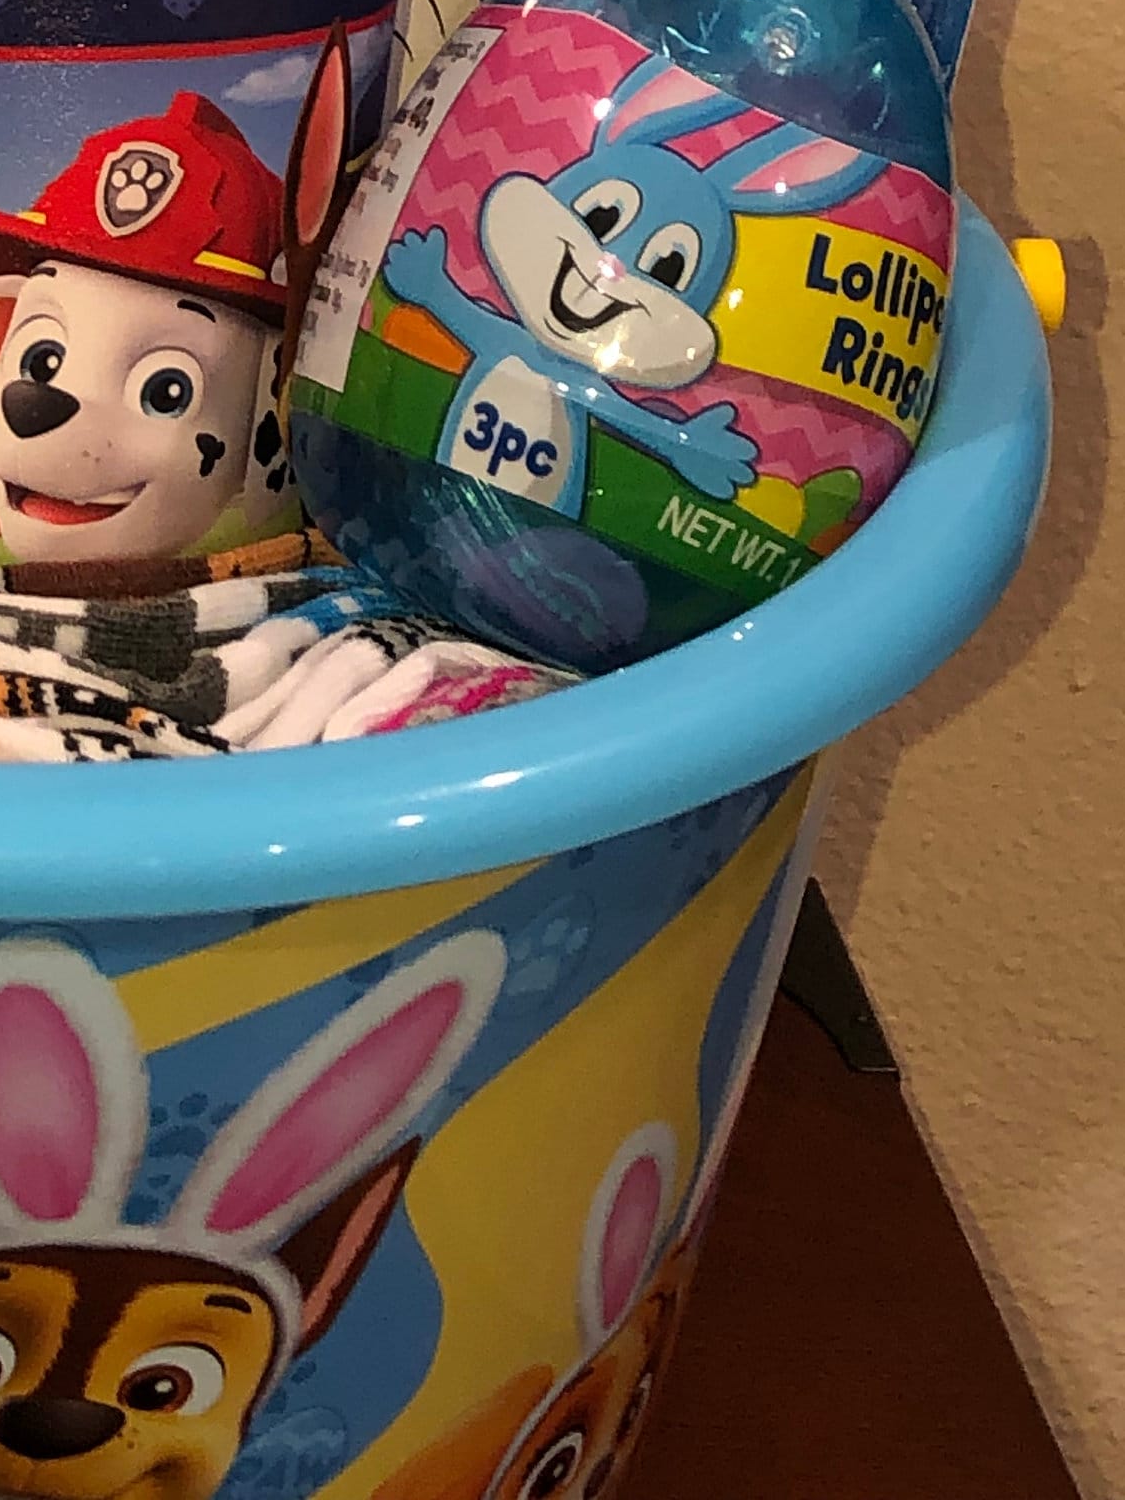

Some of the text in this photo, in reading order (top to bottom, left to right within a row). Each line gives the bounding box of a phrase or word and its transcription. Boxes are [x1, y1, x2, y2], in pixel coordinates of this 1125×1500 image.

[463, 401, 558, 477] 3pc
[657, 495, 736, 555] NET
[731, 528, 787, 583] WT.
